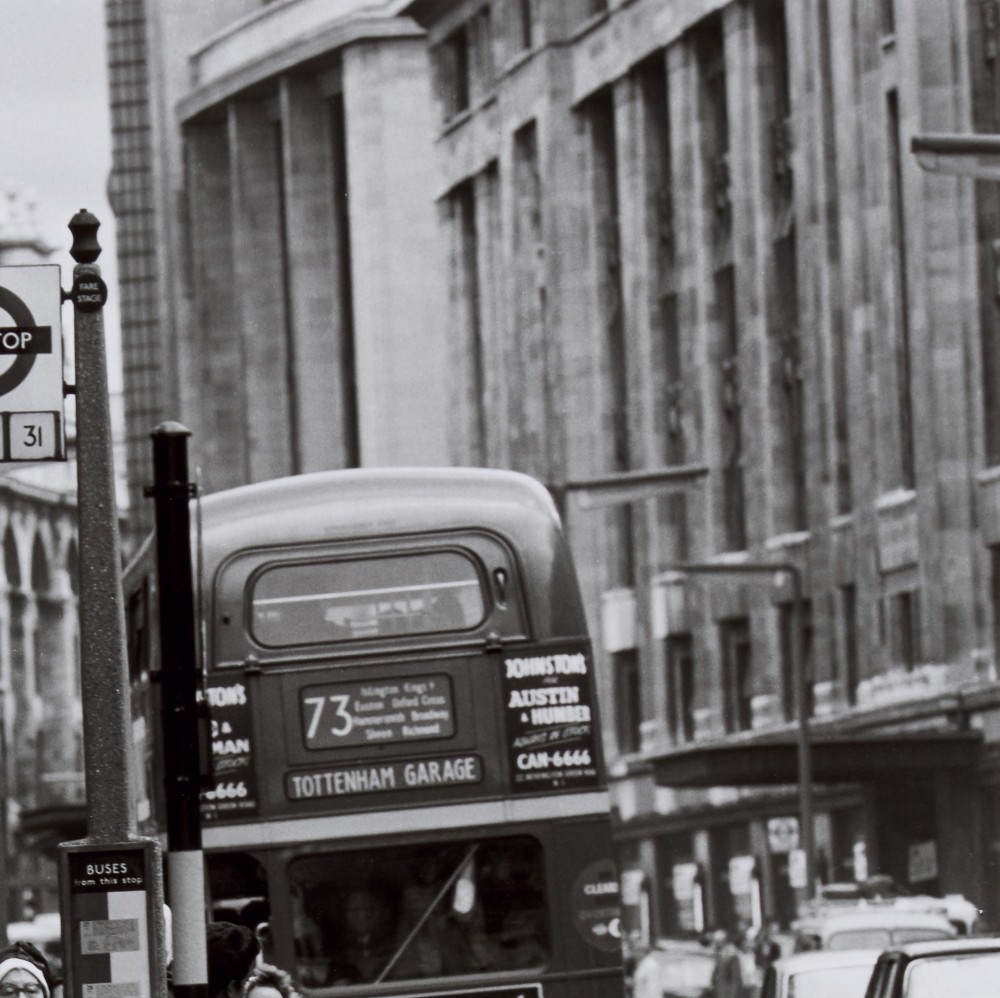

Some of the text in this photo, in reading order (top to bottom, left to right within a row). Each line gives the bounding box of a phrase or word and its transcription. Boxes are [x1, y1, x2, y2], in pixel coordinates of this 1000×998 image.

[23, 425, 43, 447] 31
[508, 686, 580, 708] AUSTIN
[304, 694, 353, 739] 73
[211, 739, 250, 755] MAN
[516, 749, 592, 770] CAN-6666
[292, 757, 477, 798] TOTTENHAM GARAGE
[86, 863, 128, 875] BUSES
[121, 876, 143, 885] stop
